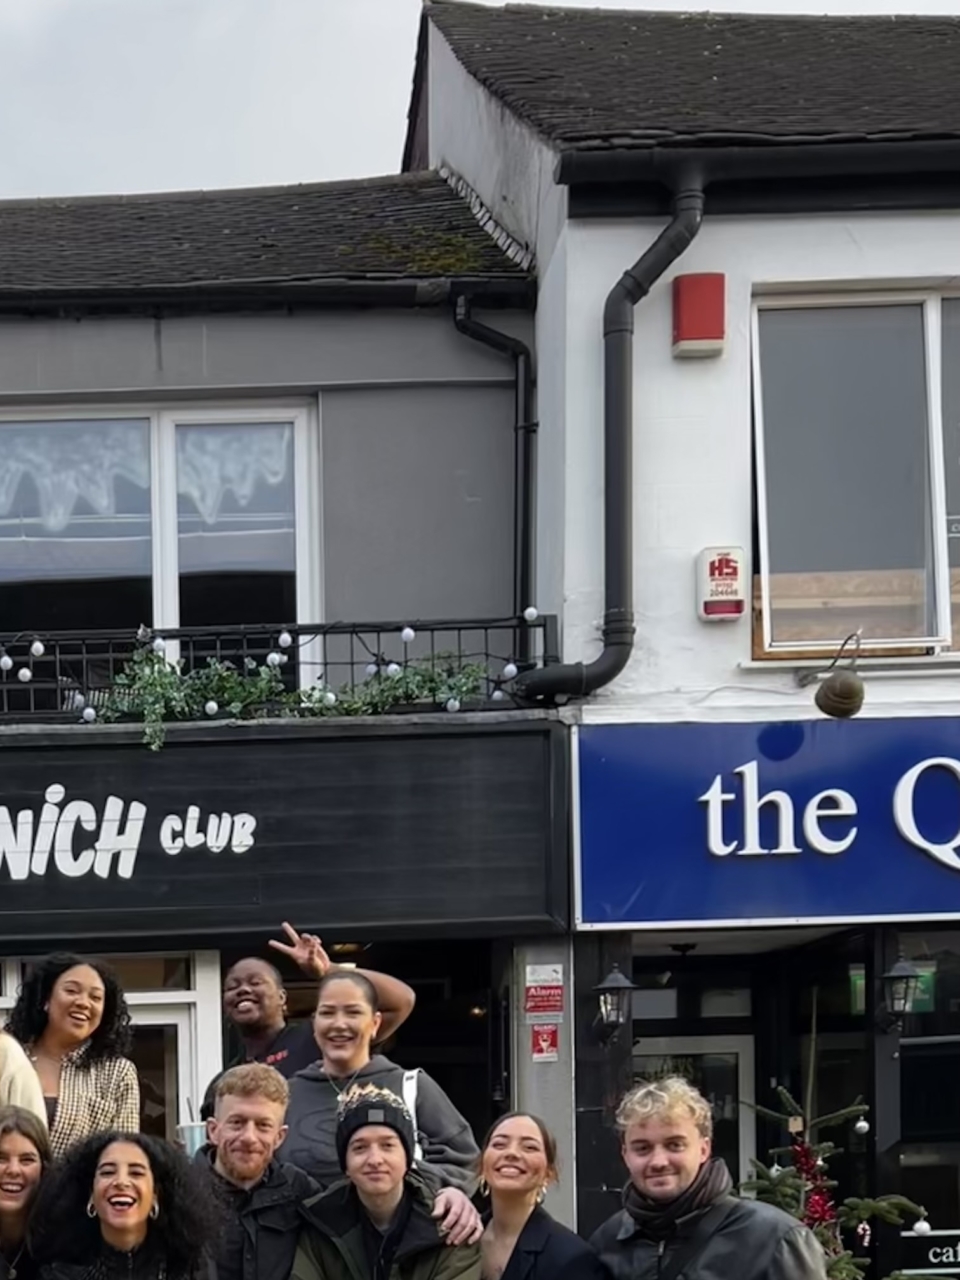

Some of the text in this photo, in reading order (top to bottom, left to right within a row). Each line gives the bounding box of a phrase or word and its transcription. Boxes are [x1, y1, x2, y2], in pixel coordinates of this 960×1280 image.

[709, 557, 738, 577] HS
[698, 760, 858, 855] the
[159, 805, 257, 855] CLUB
[527, 986, 562, 996] Alarm
